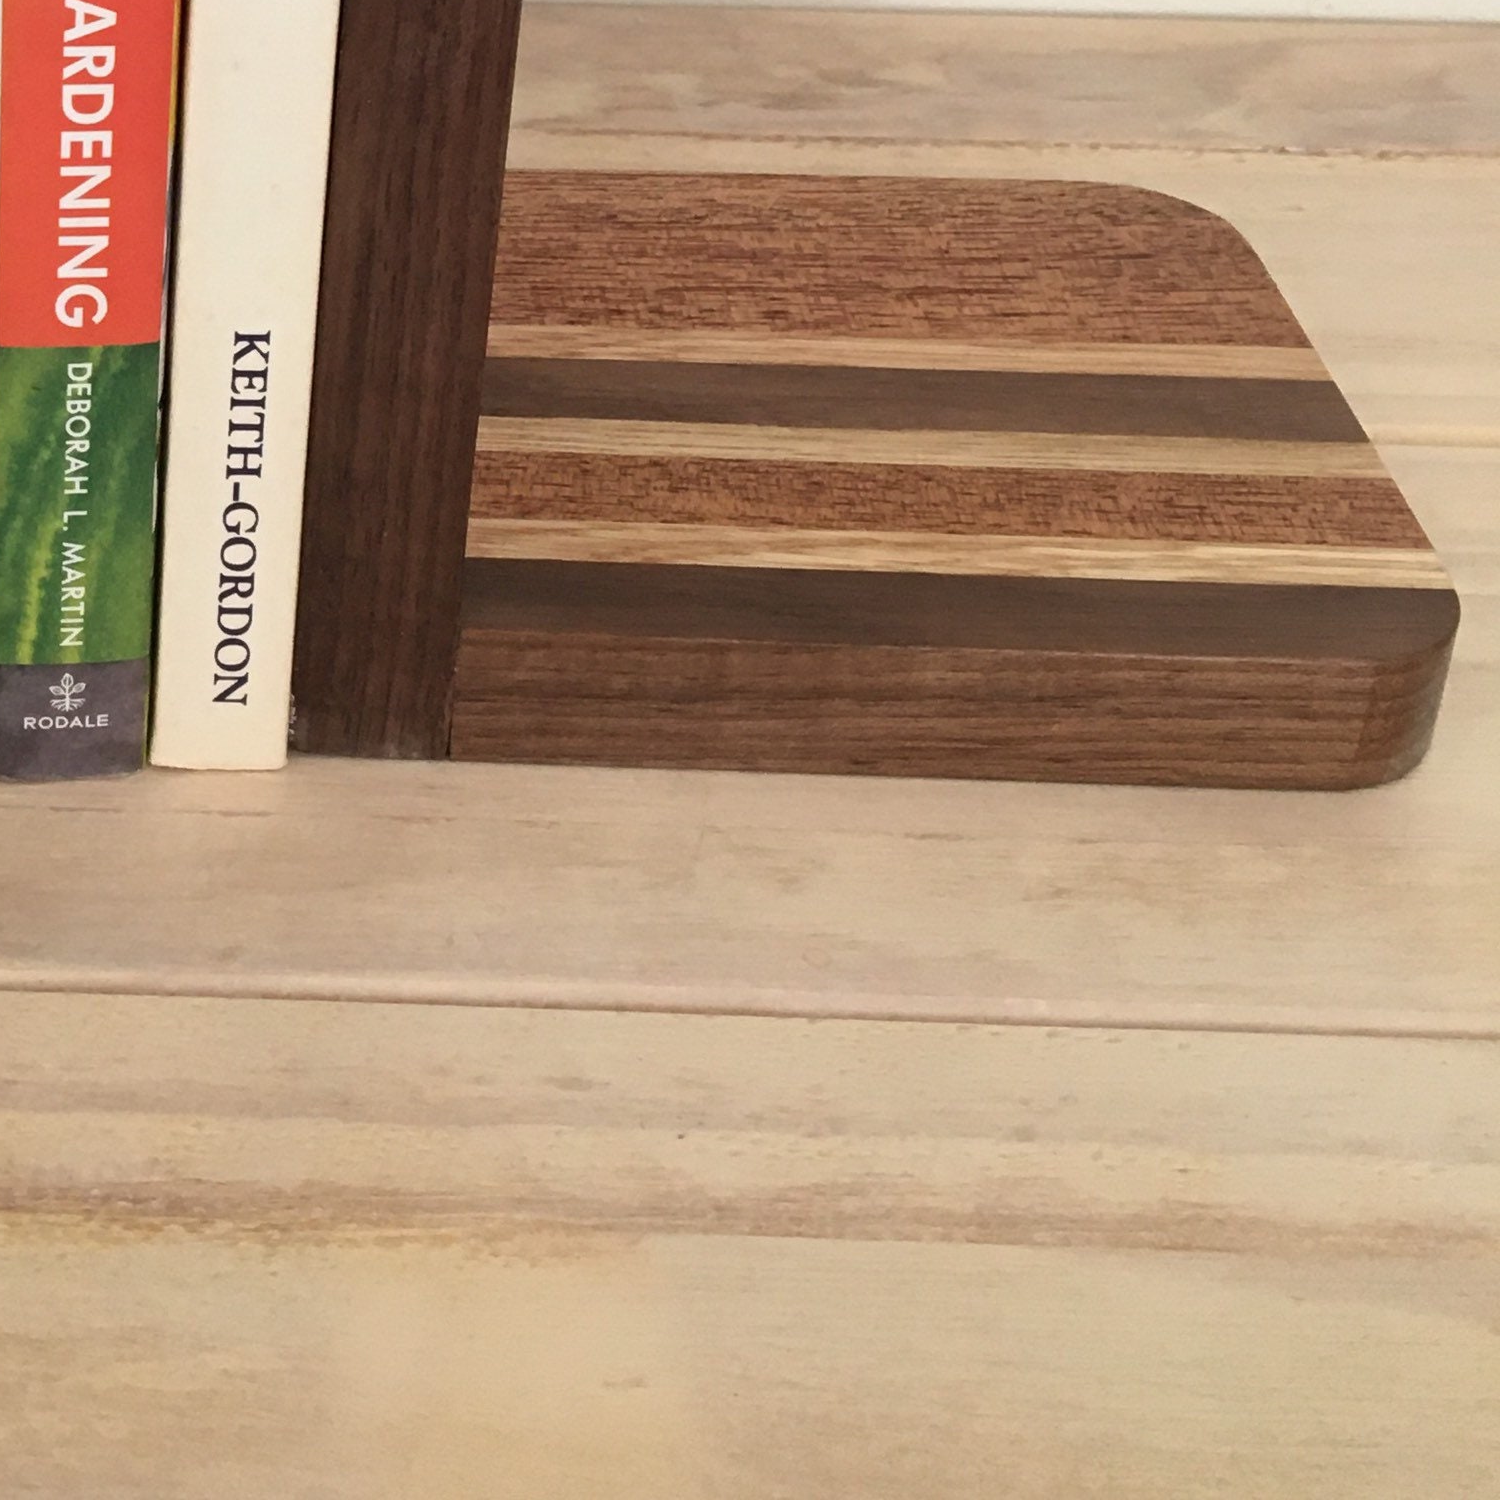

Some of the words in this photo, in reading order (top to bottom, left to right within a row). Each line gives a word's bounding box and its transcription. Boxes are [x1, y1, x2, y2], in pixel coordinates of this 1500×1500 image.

[63, 362, 93, 496] DEBORAH
[62, 510, 88, 533] L.
[212, 330, 272, 706] KEITH-GORDON
[59, 542, 84, 648] MARTIN
[23, 714, 109, 730] RODALE
